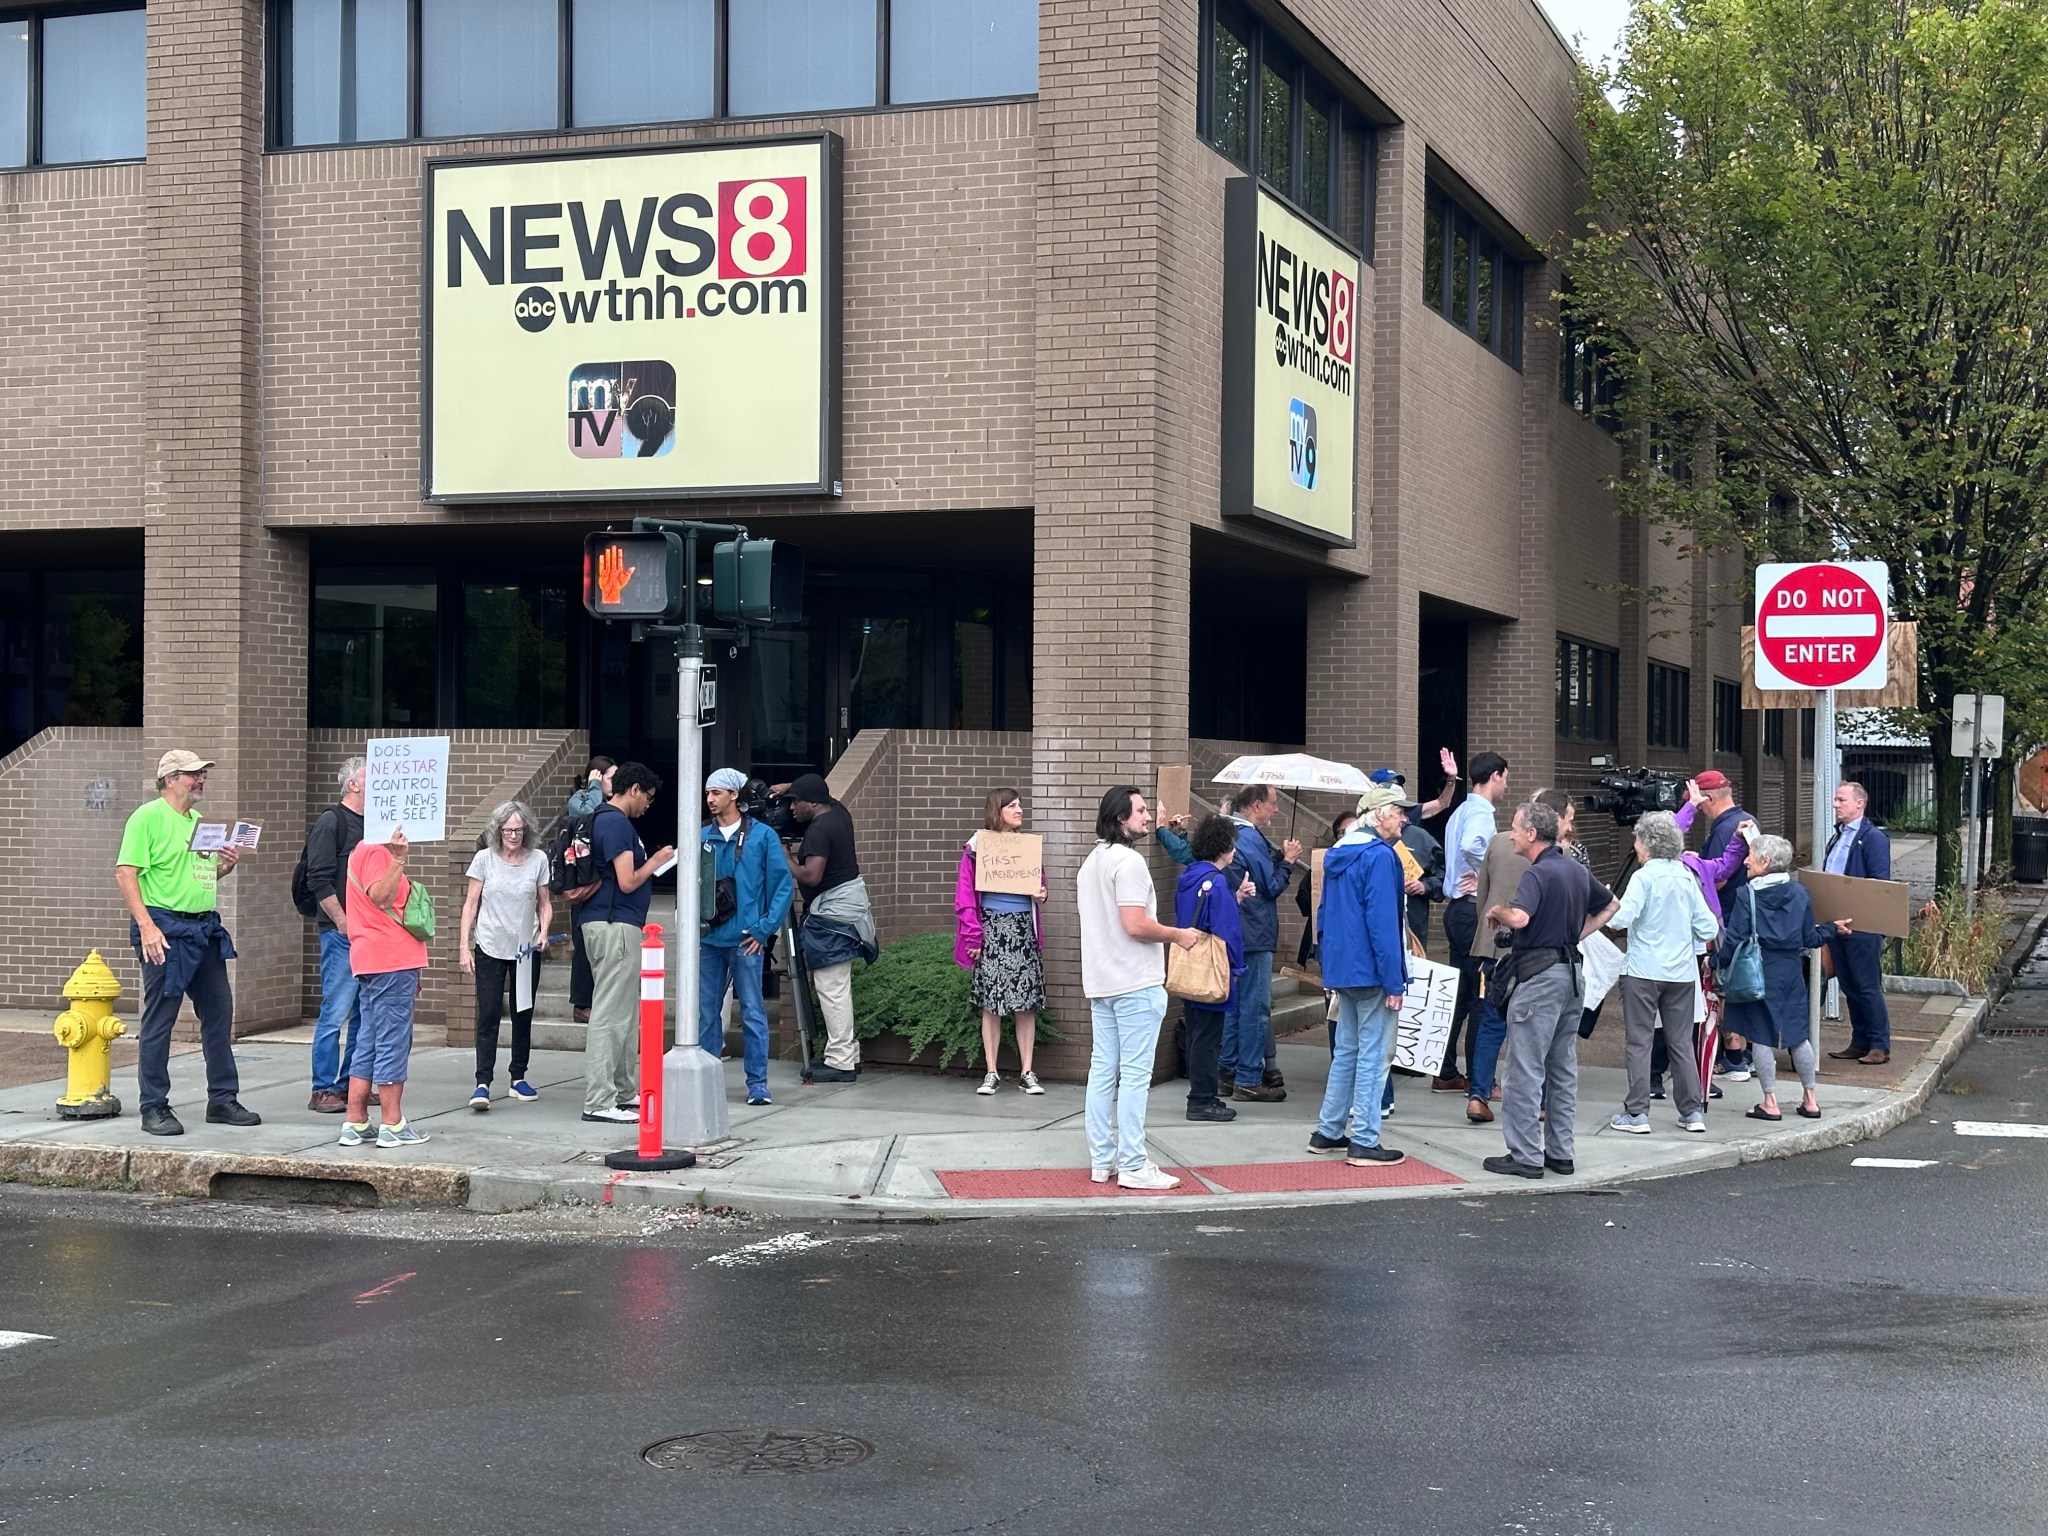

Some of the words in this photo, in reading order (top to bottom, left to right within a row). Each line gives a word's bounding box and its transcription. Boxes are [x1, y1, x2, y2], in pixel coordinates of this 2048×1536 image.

[447, 193, 716, 287] NEWS
[730, 181, 793, 276] 8
[515, 296, 556, 318] abc
[560, 275, 807, 323] wtnh.com
[1258, 230, 1329, 346] NEWS
[1333, 277, 1349, 358] 8
[1275, 332, 1287, 355] abc
[1287, 333, 1350, 396] wtnh.com
[571, 378, 638, 419] my
[568, 411, 618, 447] TV
[1290, 411, 1308, 453] my
[1289, 438, 1303, 475] TV
[1305, 437, 1316, 490] 9
[1777, 589, 1807, 609] DO
[1822, 588, 1866, 608] NOT
[1785, 644, 1856, 663] ENTER
[374, 745, 411, 757] DOES
[371, 759, 437, 775] NEXSTAR
[372, 778, 438, 790] CONTROL
[372, 795, 397, 807] THE
[405, 793, 437, 806] NEWS
[380, 809, 397, 820] WE
[981, 854, 1021, 868] FIRST
[985, 867, 1040, 883] AMENDMENT!
[1422, 977, 1456, 1071] WHERE'S
